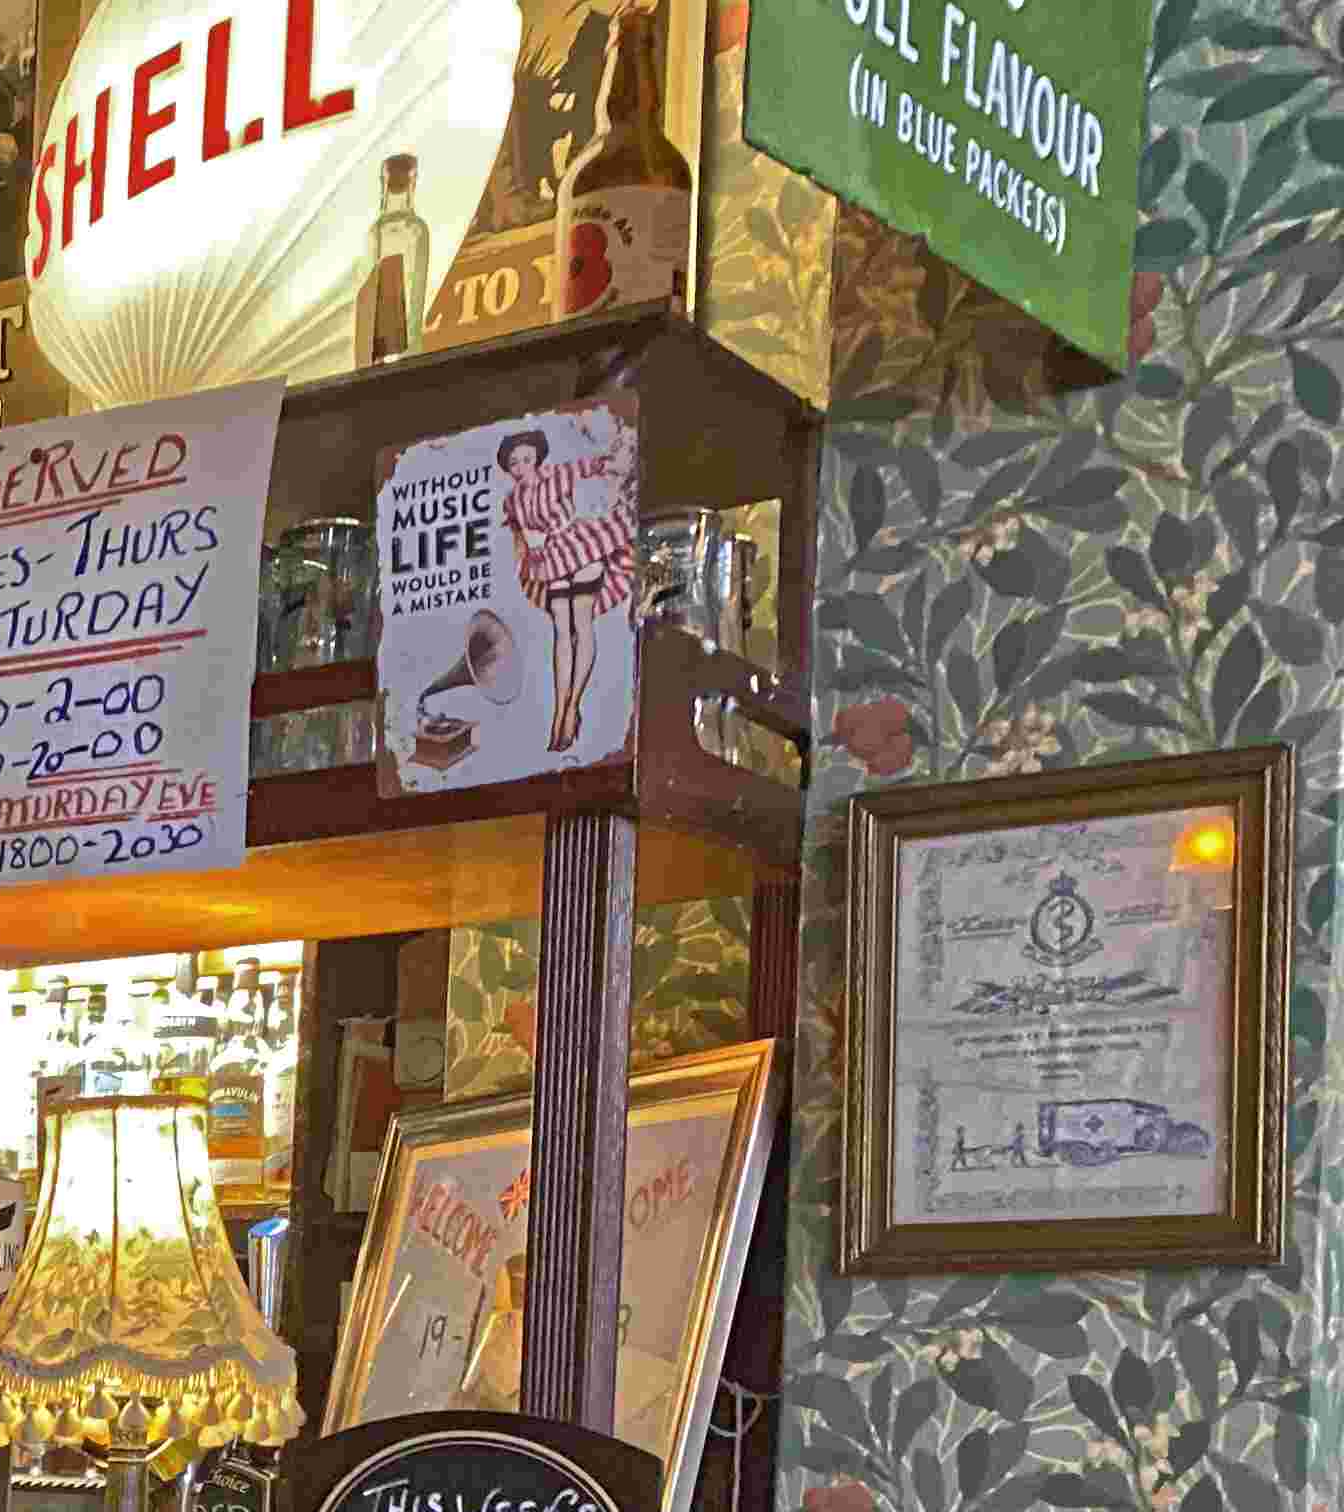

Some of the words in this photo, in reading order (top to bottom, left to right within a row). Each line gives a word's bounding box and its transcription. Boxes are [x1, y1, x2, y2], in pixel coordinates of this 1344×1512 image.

[940, 2, 1103, 198] FLAVOUR
[31, 0, 357, 281] SHELL
[849, 52, 887, 128] (IN
[896, 92, 958, 173] BLUE
[965, 138, 1066, 256] PACKETS)
[454, 267, 520, 325] TO
[392, 465, 492, 501] WITHOUT
[392, 489, 491, 532] MUSIC
[67, 506, 219, 577] THURS
[392, 518, 491, 573] LIFE
[392, 569, 461, 596] WOULD
[469, 562, 491, 581] BE
[392, 602, 403, 616] A
[410, 584, 491, 614] MISTAKE
[160, 775, 216, 814] EVE
[629, 1158, 695, 1231] OME
